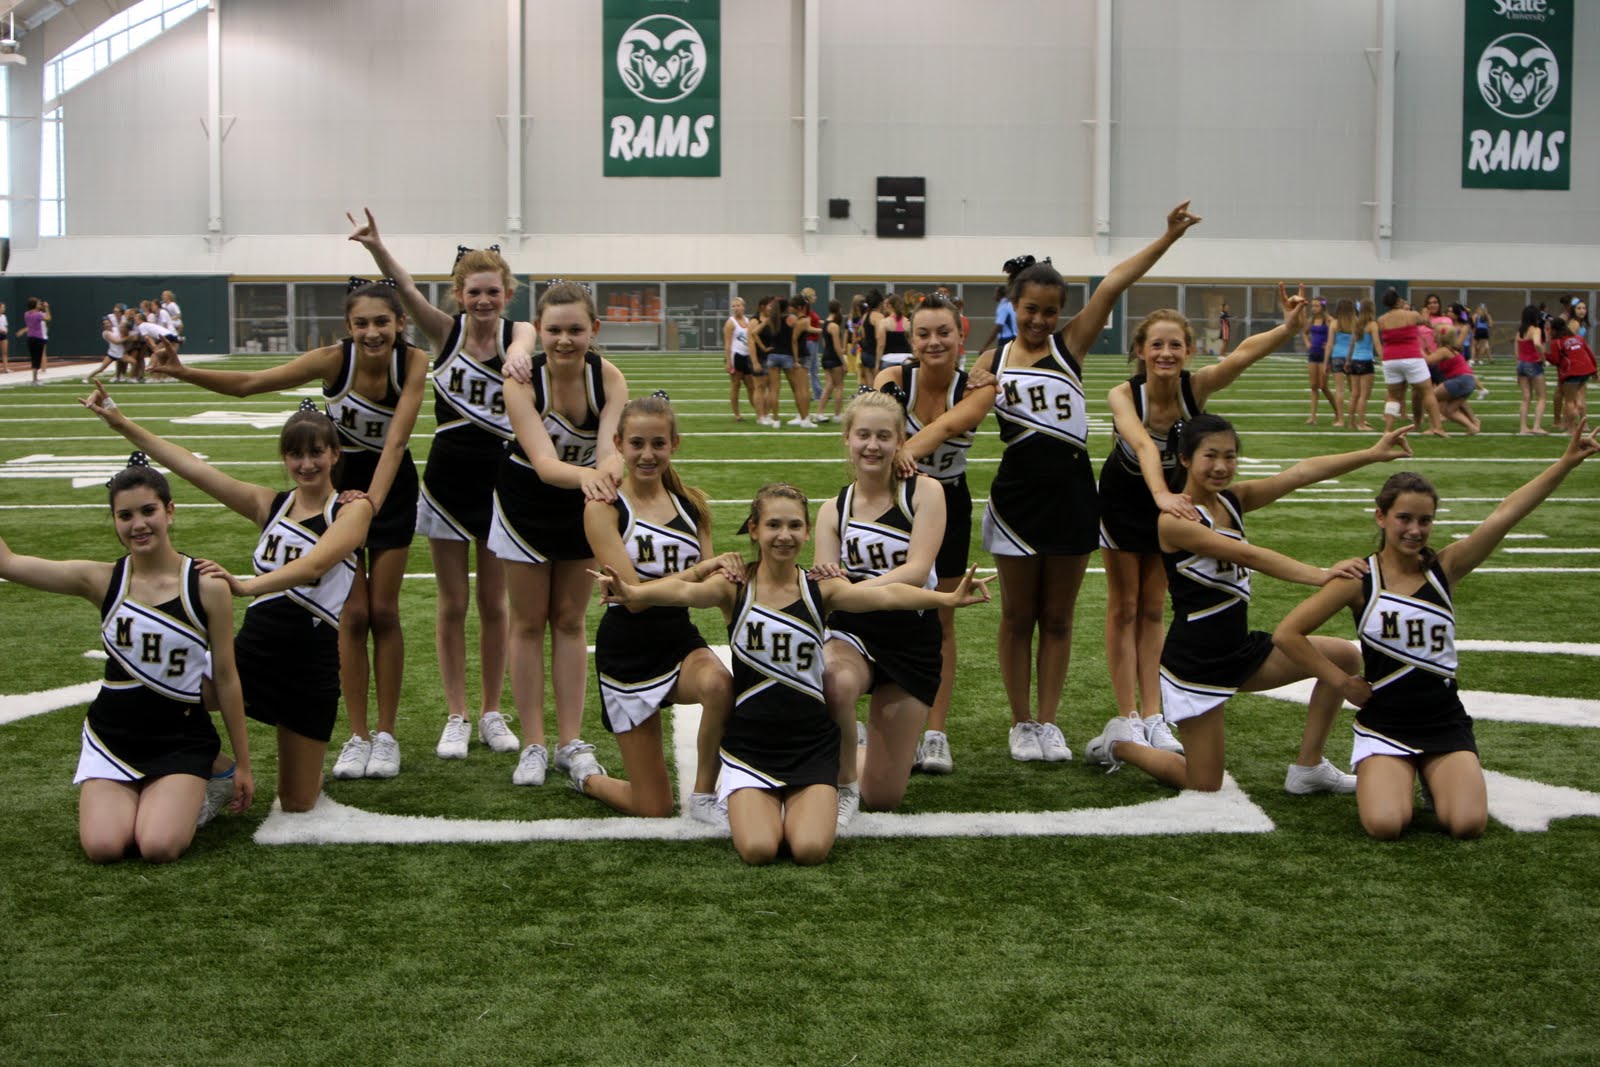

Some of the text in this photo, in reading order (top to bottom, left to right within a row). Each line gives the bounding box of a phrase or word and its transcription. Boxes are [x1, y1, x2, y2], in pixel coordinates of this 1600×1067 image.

[1506, 12, 1546, 21] University
[609, 114, 715, 161] RAMS
[1468, 129, 1565, 174] RAMS
[448, 367, 506, 415] MHS
[1002, 379, 1072, 421] MHS
[340, 404, 385, 438] MH
[116, 616, 190, 678] MHS
[745, 621, 817, 672] MHS
[1380, 611, 1447, 653] MHS
